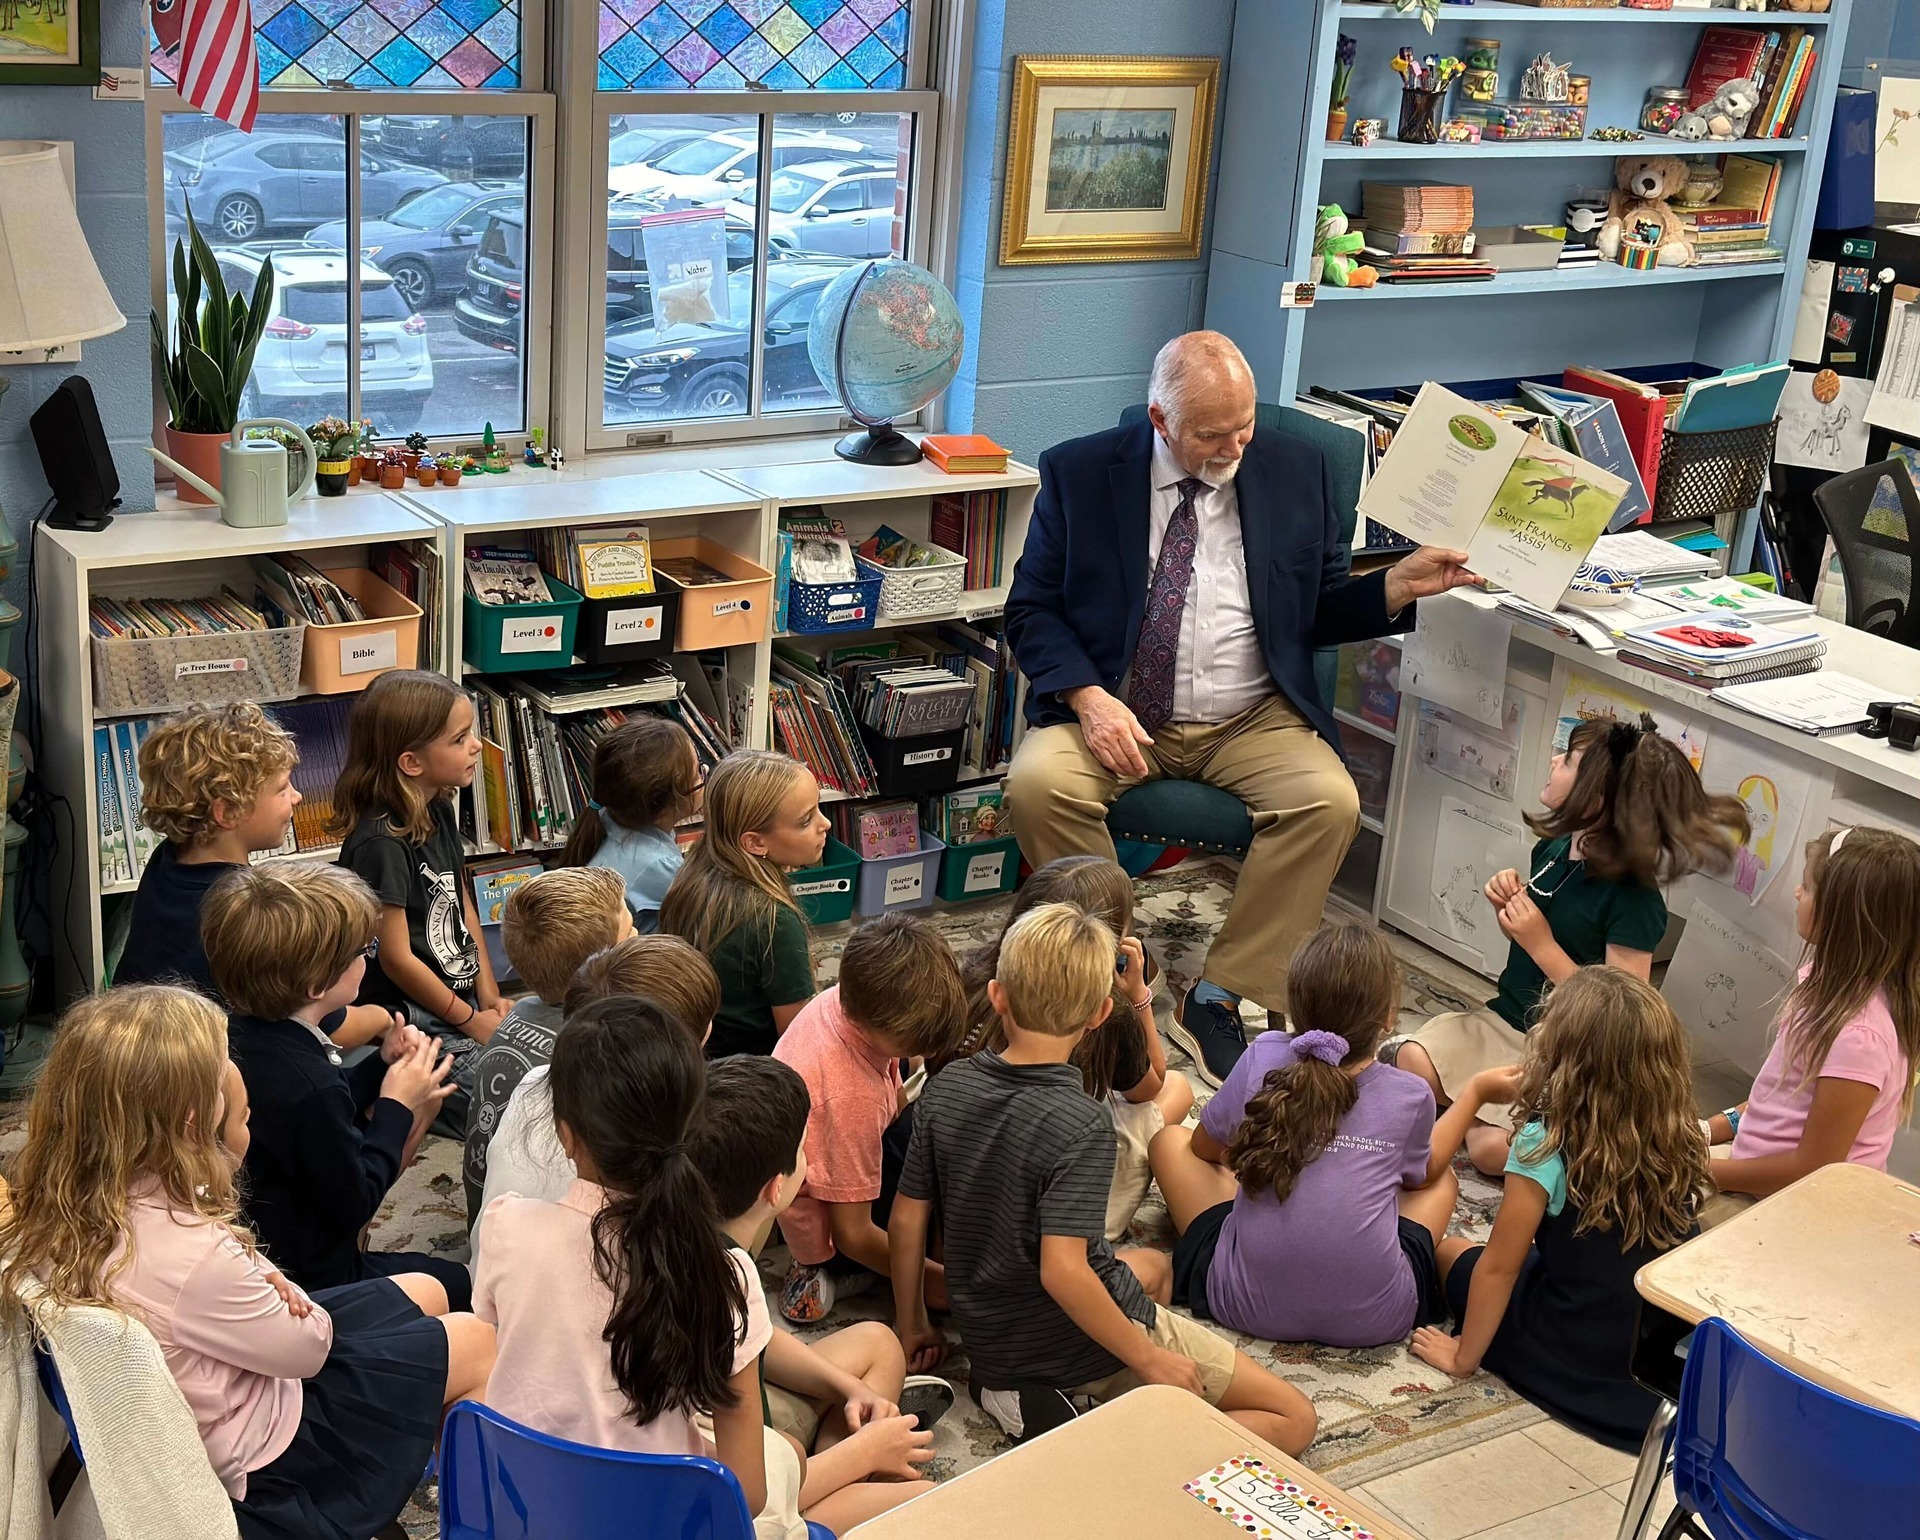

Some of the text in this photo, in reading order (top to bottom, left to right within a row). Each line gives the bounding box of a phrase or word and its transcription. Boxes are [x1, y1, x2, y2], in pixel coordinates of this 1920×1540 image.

[685, 264, 707, 275] Water
[786, 519, 845, 534] Animals 2
[796, 532, 833, 540] Australia
[1511, 531, 1547, 551] ASSISI
[1525, 520, 1574, 552] FRANCIS
[470, 550, 478, 558] 3
[591, 548, 607, 564] HENRY
[621, 547, 642, 562] MUDGE
[715, 603, 731, 612] Level
[830, 612, 853, 621] Animals
[972, 609, 994, 618] Chapter
[614, 619, 643, 631] Level 2
[512, 627, 543, 639] Level 3
[352, 648, 375, 659] Bible
[190, 663, 207, 672] Tree
[208, 661, 231, 670] House
[910, 752, 935, 761] History
[971, 864, 993, 873] Chapter
[890, 876, 914, 886] Chapter
[796, 884, 819, 892] Chapter
[892, 884, 910, 892] Books
[482, 890, 501, 900] The
[481, 1111, 493, 1124] 25
[1333, 1140, 1355, 1149] STAND
[1256, 1493, 1304, 1526] Ella
